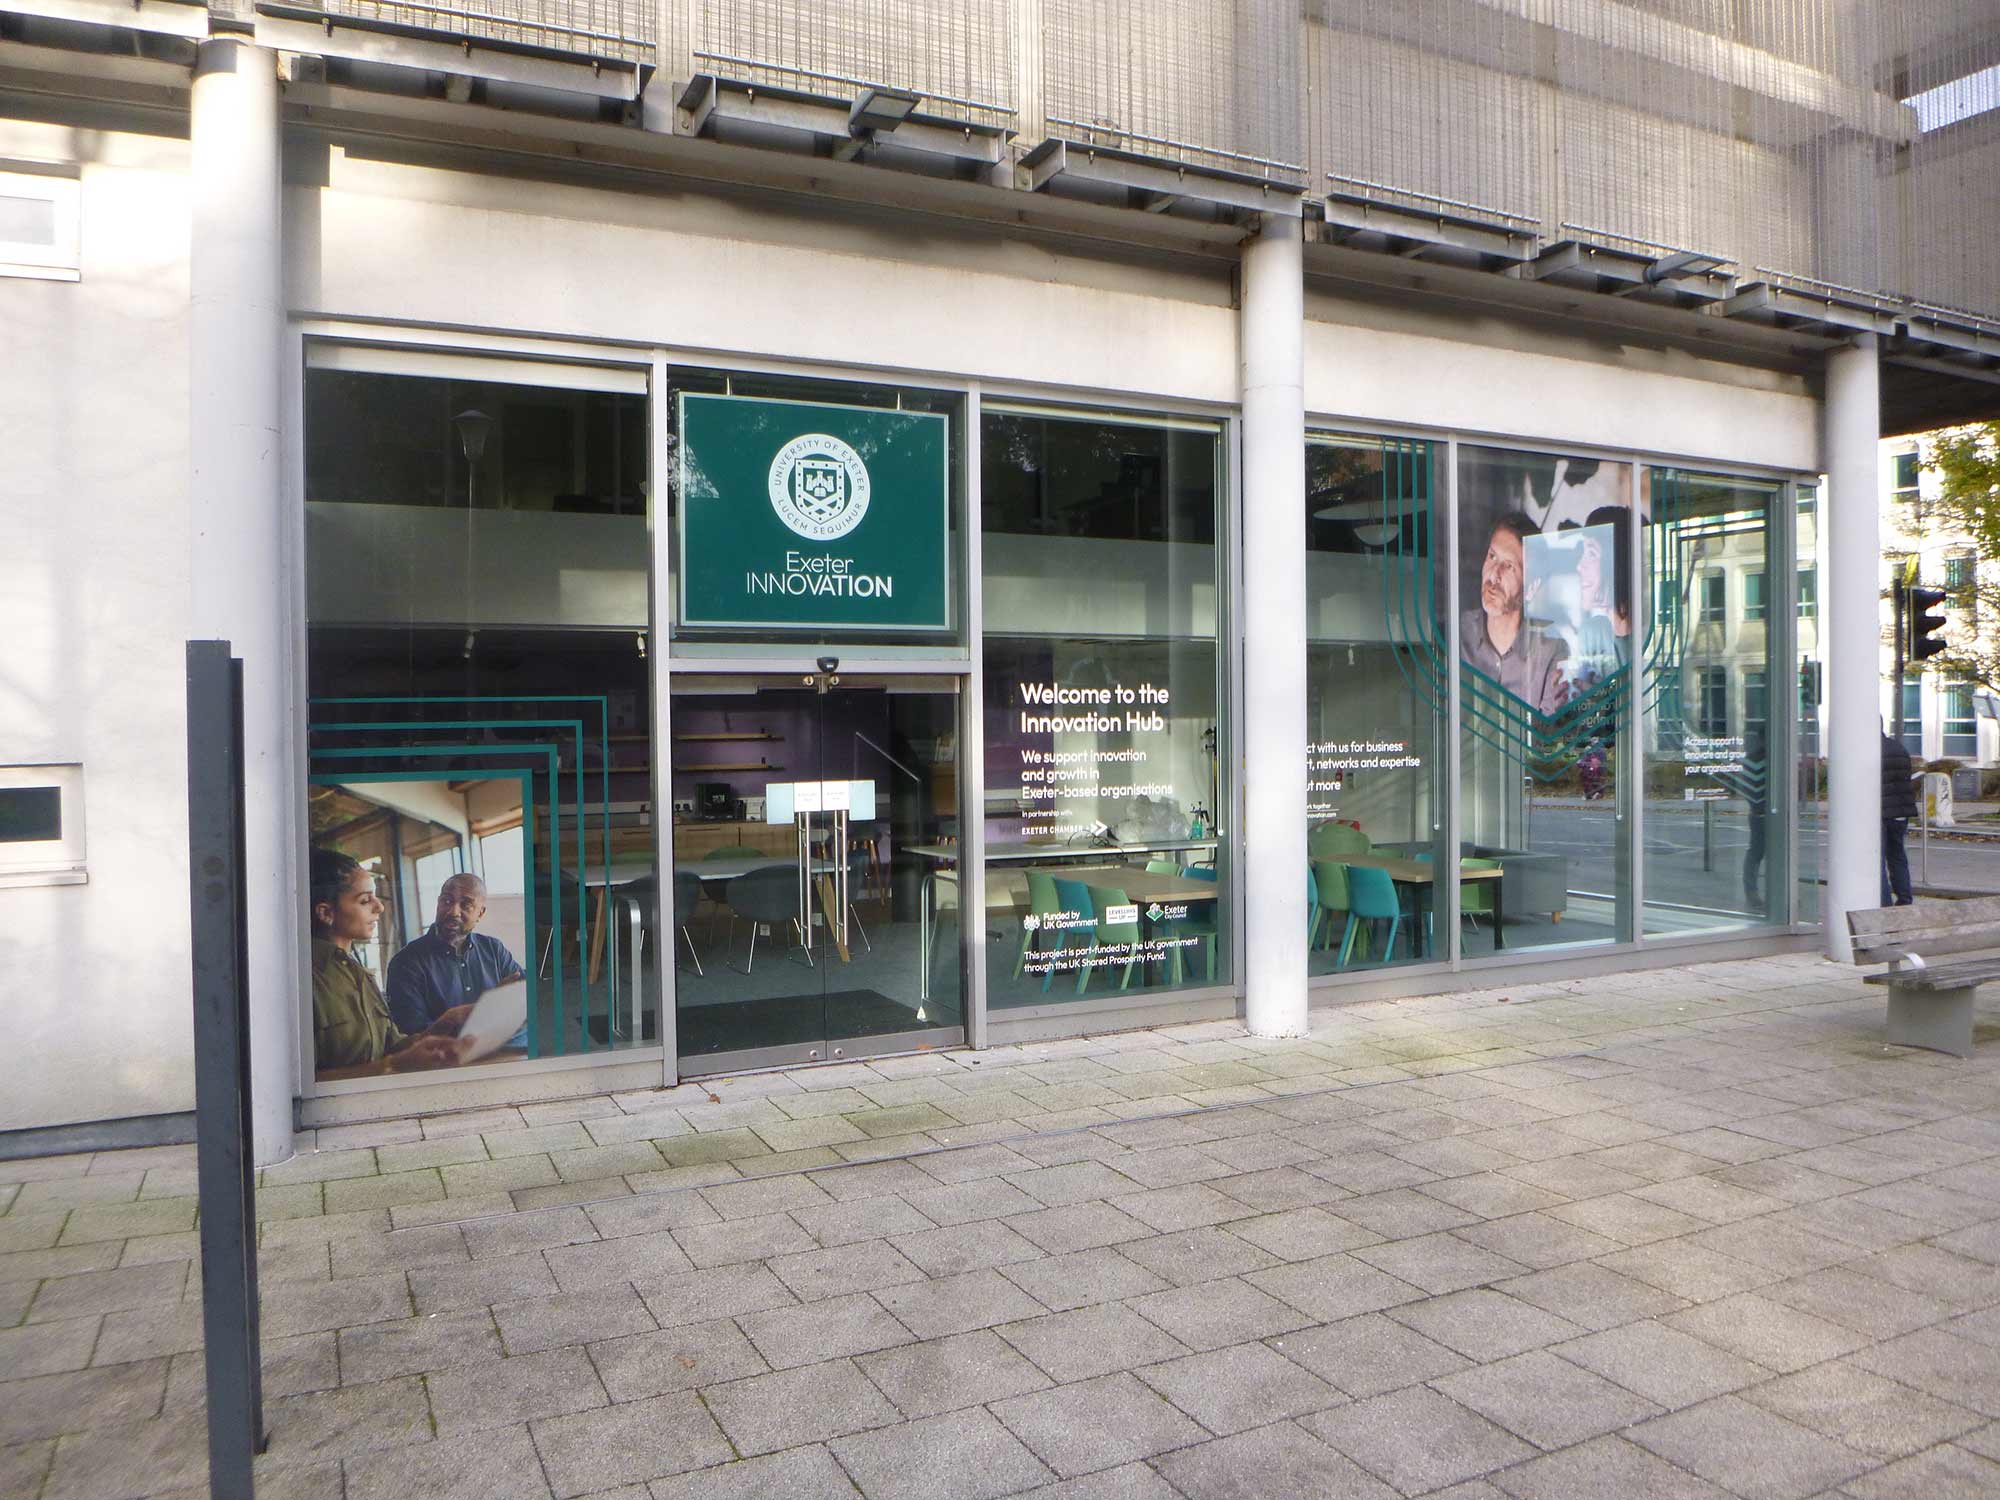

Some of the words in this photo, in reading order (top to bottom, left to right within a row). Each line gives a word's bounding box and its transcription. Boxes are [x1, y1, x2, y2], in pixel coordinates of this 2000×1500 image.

[774, 440, 819, 486] UNIVERSITY
[824, 441, 838, 451] OF
[841, 450, 865, 492] EXETER
[777, 498, 808, 531] LUCEM
[813, 503, 862, 535] SEQUIMUR
[786, 551, 854, 574] Exeter
[746, 572, 893, 598] INNOVATION
[1020, 683, 1111, 704] Welcome
[1115, 684, 1135, 704] to
[1138, 683, 1169, 704] the
[1021, 711, 1121, 733] Innovation
[1126, 711, 1164, 732] Hub
[1317, 741, 1337, 754] with
[1338, 744, 1349, 753] us
[1350, 741, 1364, 753] for
[1366, 741, 1403, 753] business
[1021, 750, 1042, 764] We
[1043, 750, 1088, 766] support
[1090, 750, 1147, 762] innovation
[1316, 757, 1359, 770] networks
[1360, 756, 1378, 768] and
[1380, 755, 1421, 770] expertise
[1021, 768, 1044, 782] and
[1046, 767, 1088, 784] growth
[1089, 766, 1100, 780] in
[1684, 765, 1701, 776] your
[1022, 784, 1098, 800] Exeter-based
[1100, 783, 1173, 800] organisations
[1316, 781, 1341, 791] more
[1028, 810, 1060, 819] partnership
[1021, 826, 1048, 835] EXETER
[1049, 824, 1083, 834] CHAMBER
[1043, 912, 1070, 922] Funded
[1071, 911, 1081, 922] by
[1164, 905, 1188, 914] Exeter
[1043, 920, 1055, 930] UK
[1056, 918, 1099, 929] Government
[1024, 951, 1039, 960] This
[1040, 948, 1068, 961] project
[1068, 948, 1074, 957] is
[1075, 944, 1120, 958] part-funded
[1120, 943, 1131, 954] by
[1131, 942, 1143, 952] the
[1144, 941, 1155, 950] UK
[1156, 937, 1199, 950] government
[1023, 962, 1054, 973] through
[1055, 960, 1068, 970] the
[1068, 959, 1080, 969] UK
[1081, 957, 1108, 968] Shared
[1109, 954, 1146, 966] Prosperity
[1146, 951, 1166, 961] Fund.
